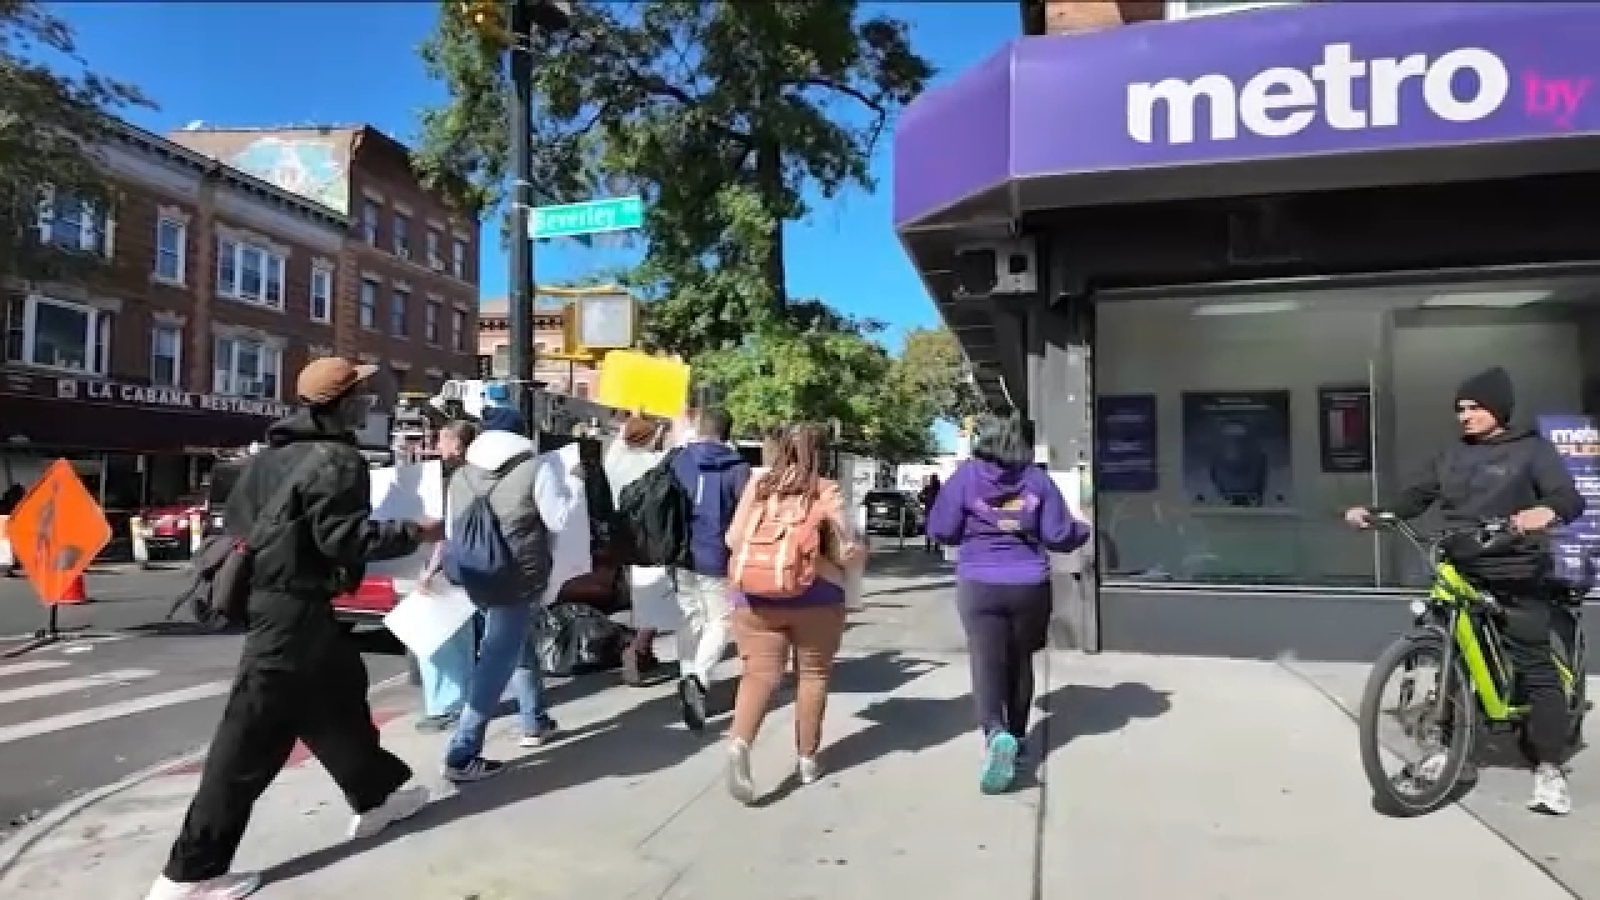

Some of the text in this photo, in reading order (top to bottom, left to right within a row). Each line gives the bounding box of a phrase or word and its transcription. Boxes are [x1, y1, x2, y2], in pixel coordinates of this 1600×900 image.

[1125, 42, 1589, 145] metro by
[88, 380, 112, 398] LA
